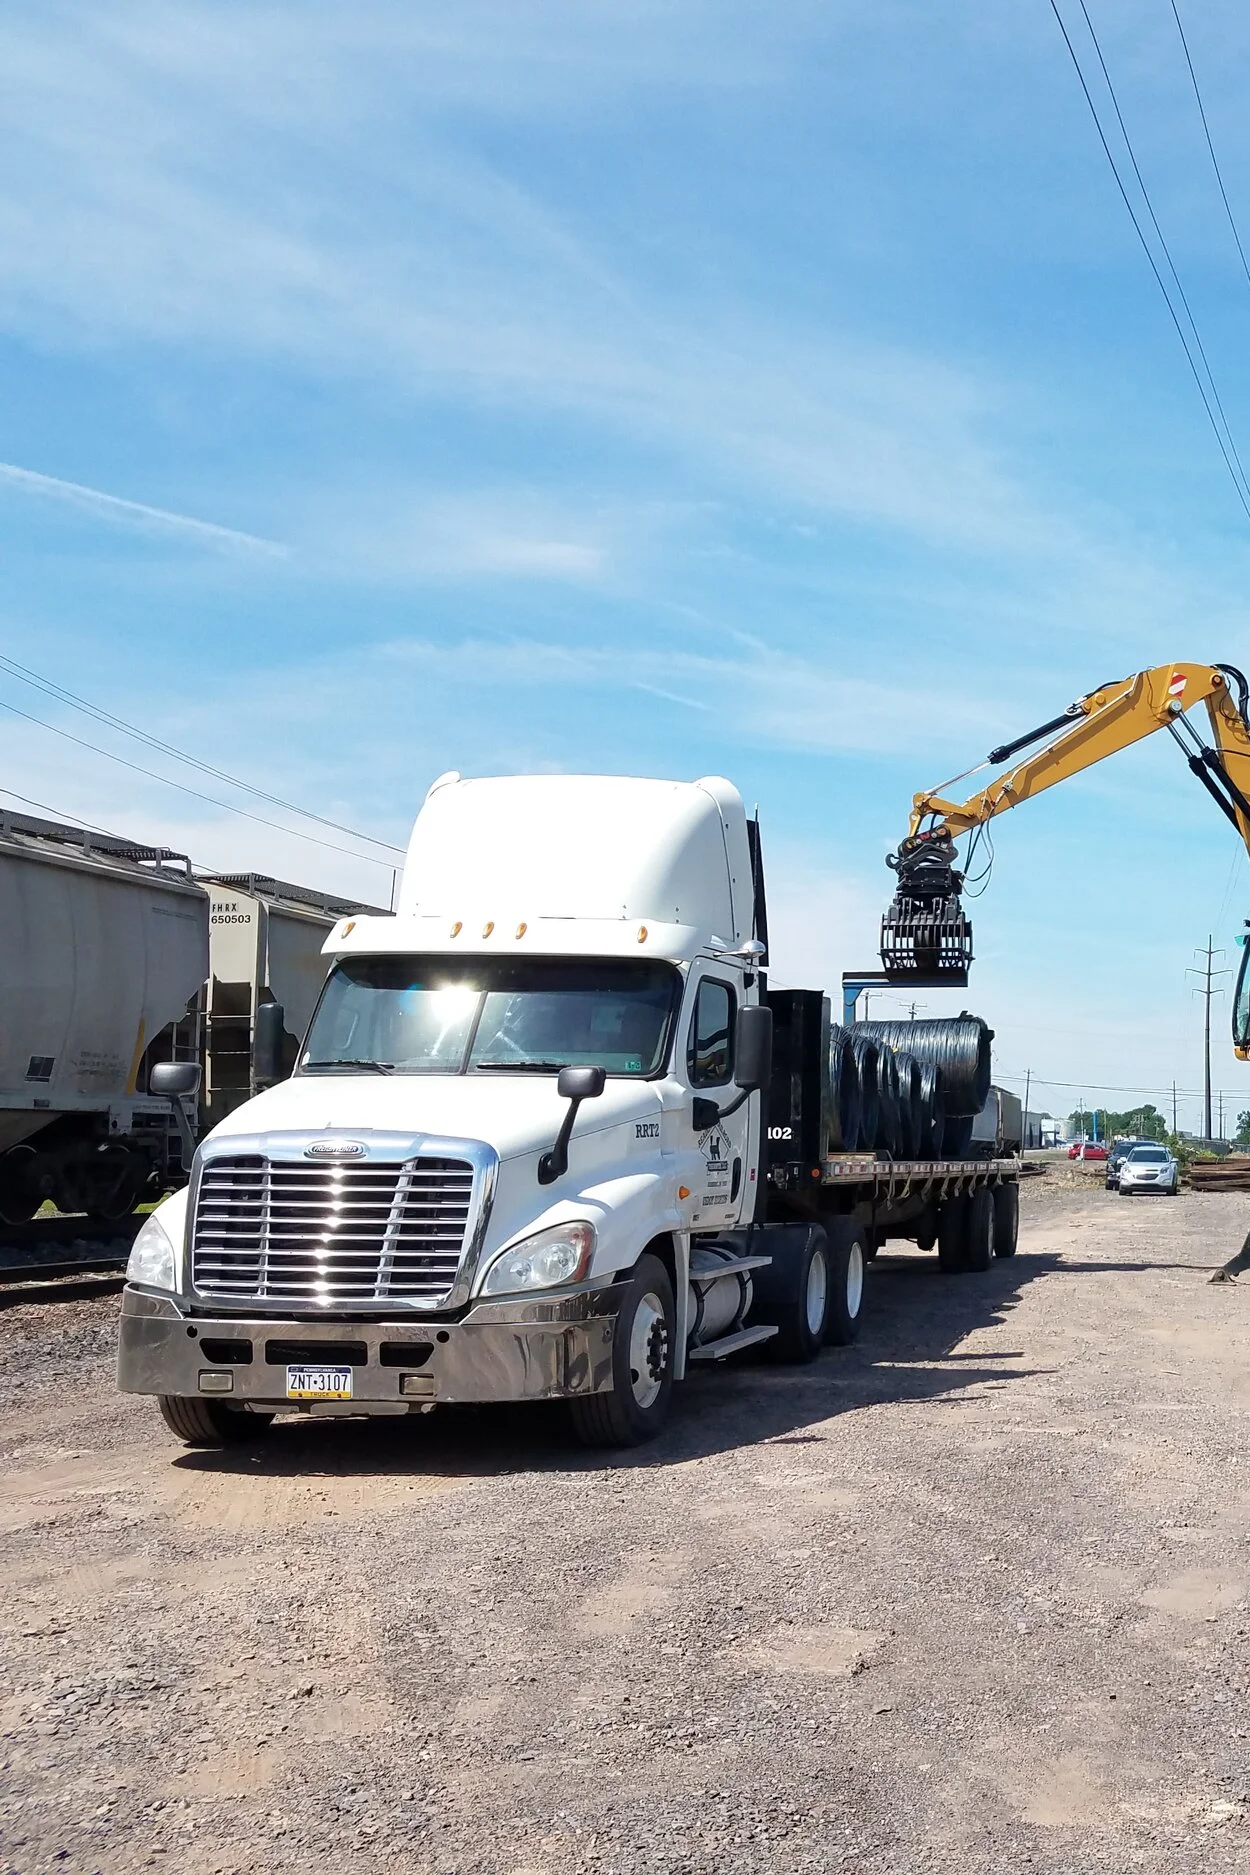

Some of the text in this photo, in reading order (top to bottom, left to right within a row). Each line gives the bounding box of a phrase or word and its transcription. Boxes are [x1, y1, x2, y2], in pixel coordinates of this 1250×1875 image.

[212, 903, 237, 912] FHRX
[211, 914, 251, 924] 650503
[635, 1123, 660, 1138] RRT2
[767, 1126, 792, 1140] 102
